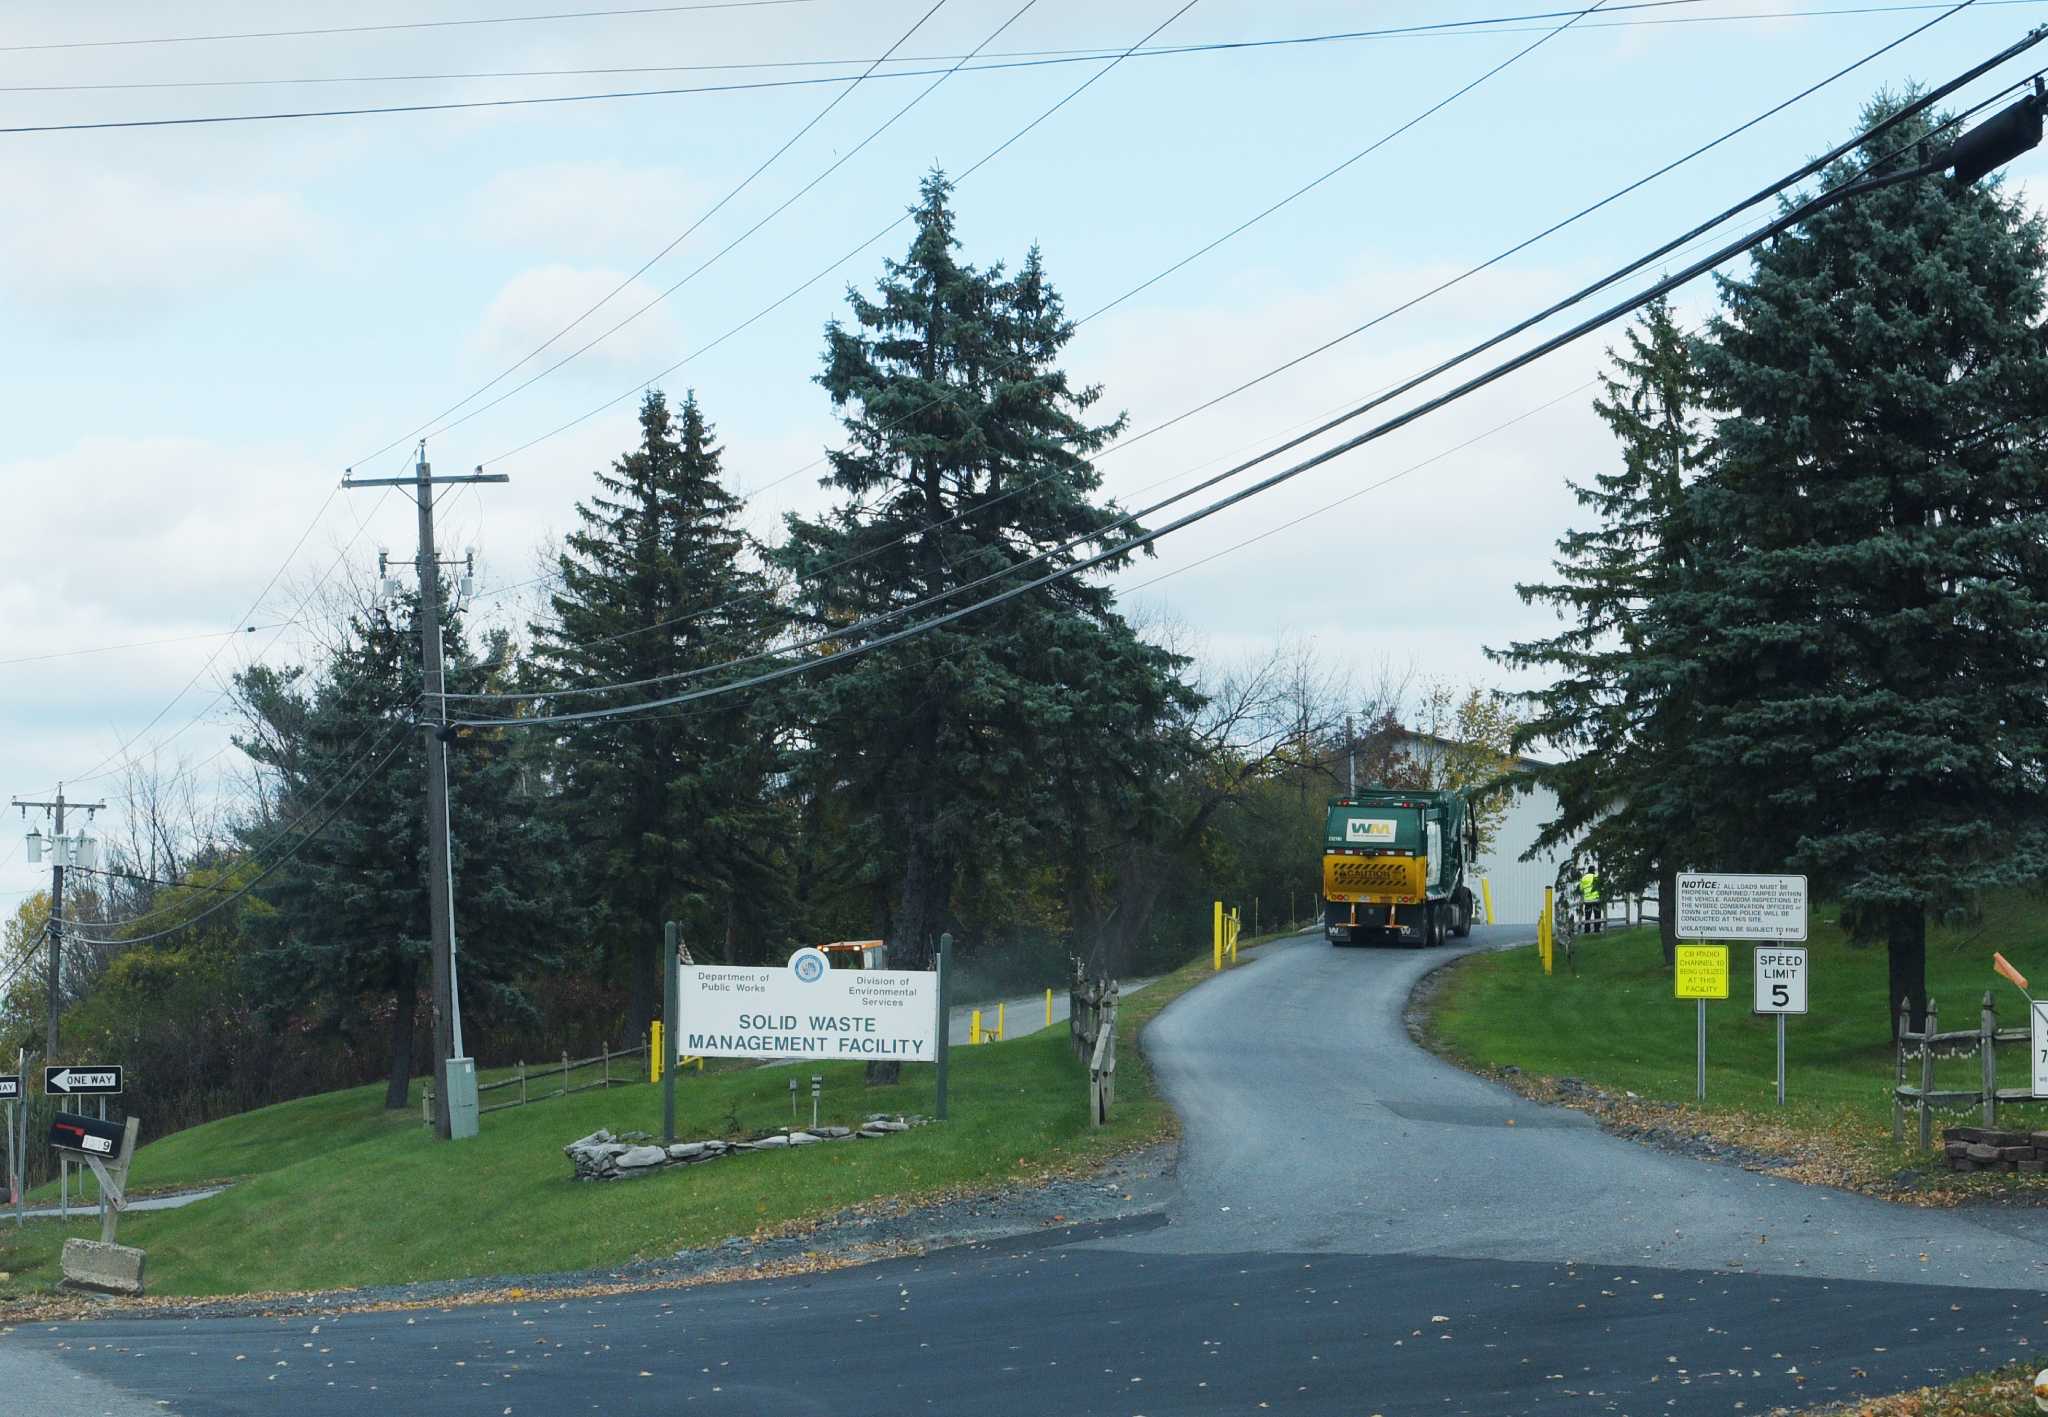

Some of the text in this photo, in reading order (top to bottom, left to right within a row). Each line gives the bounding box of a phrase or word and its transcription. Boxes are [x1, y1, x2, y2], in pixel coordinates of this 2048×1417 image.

[1352, 823, 1390, 834] WM
[1681, 881, 1720, 889] NOTICE:
[1760, 955, 1803, 966] SPEED
[698, 972, 770, 984] Department of
[1764, 970, 1797, 979] LIMIT
[856, 976, 910, 986] Division of
[701, 983, 765, 993] Public Works
[849, 987, 917, 997] Environmental
[1686, 985, 1718, 993] FACILITY
[1772, 984, 1790, 1007] 5
[862, 997, 904, 1007] Services
[739, 1014, 876, 1032] SOLID WASTE
[688, 1034, 925, 1054] MANAGEMENT FACILITY
[67, 1075, 113, 1085] ONE WAY
